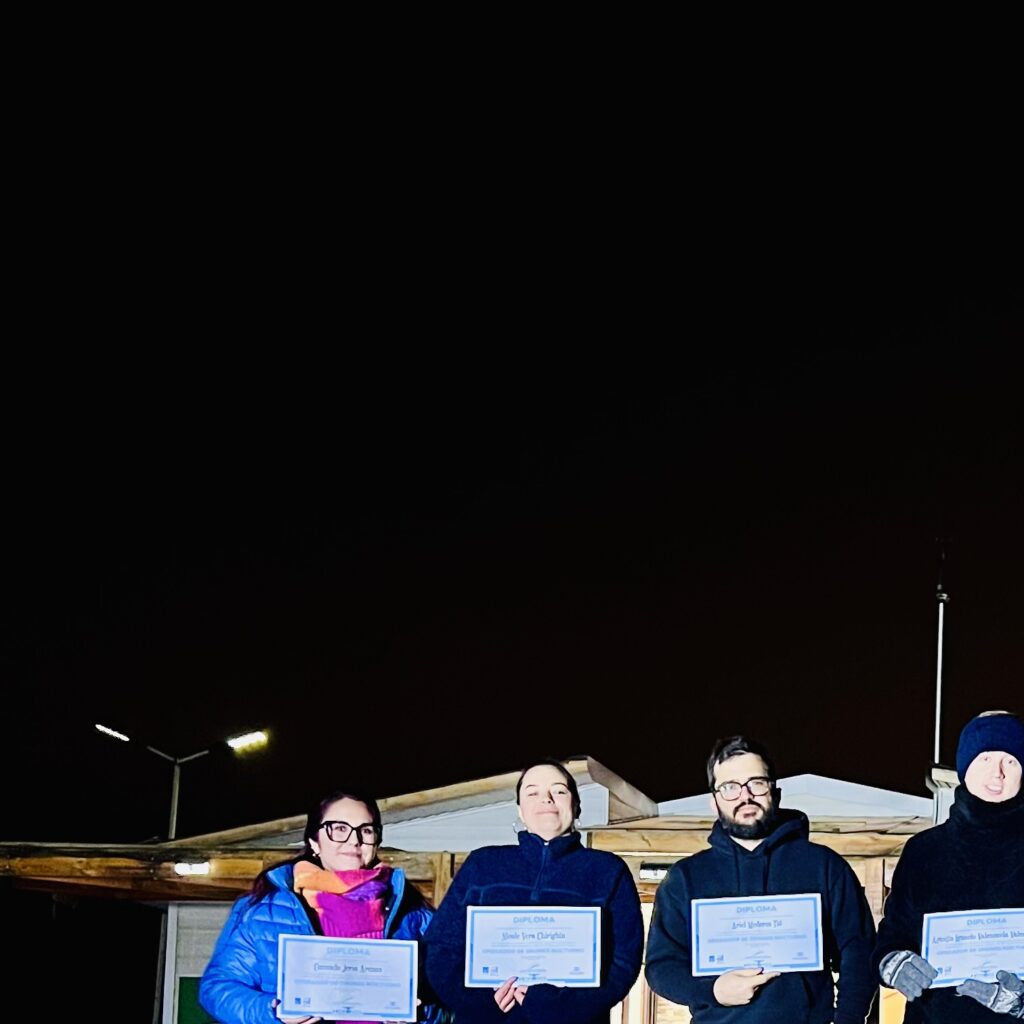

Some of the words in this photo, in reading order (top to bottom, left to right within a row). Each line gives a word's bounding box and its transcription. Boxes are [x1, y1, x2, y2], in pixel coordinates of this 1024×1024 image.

[736, 905, 776, 913] DIPLOMA
[967, 918, 1007, 926] DIPLOMA
[326, 947, 370, 955] DIPLOMA
